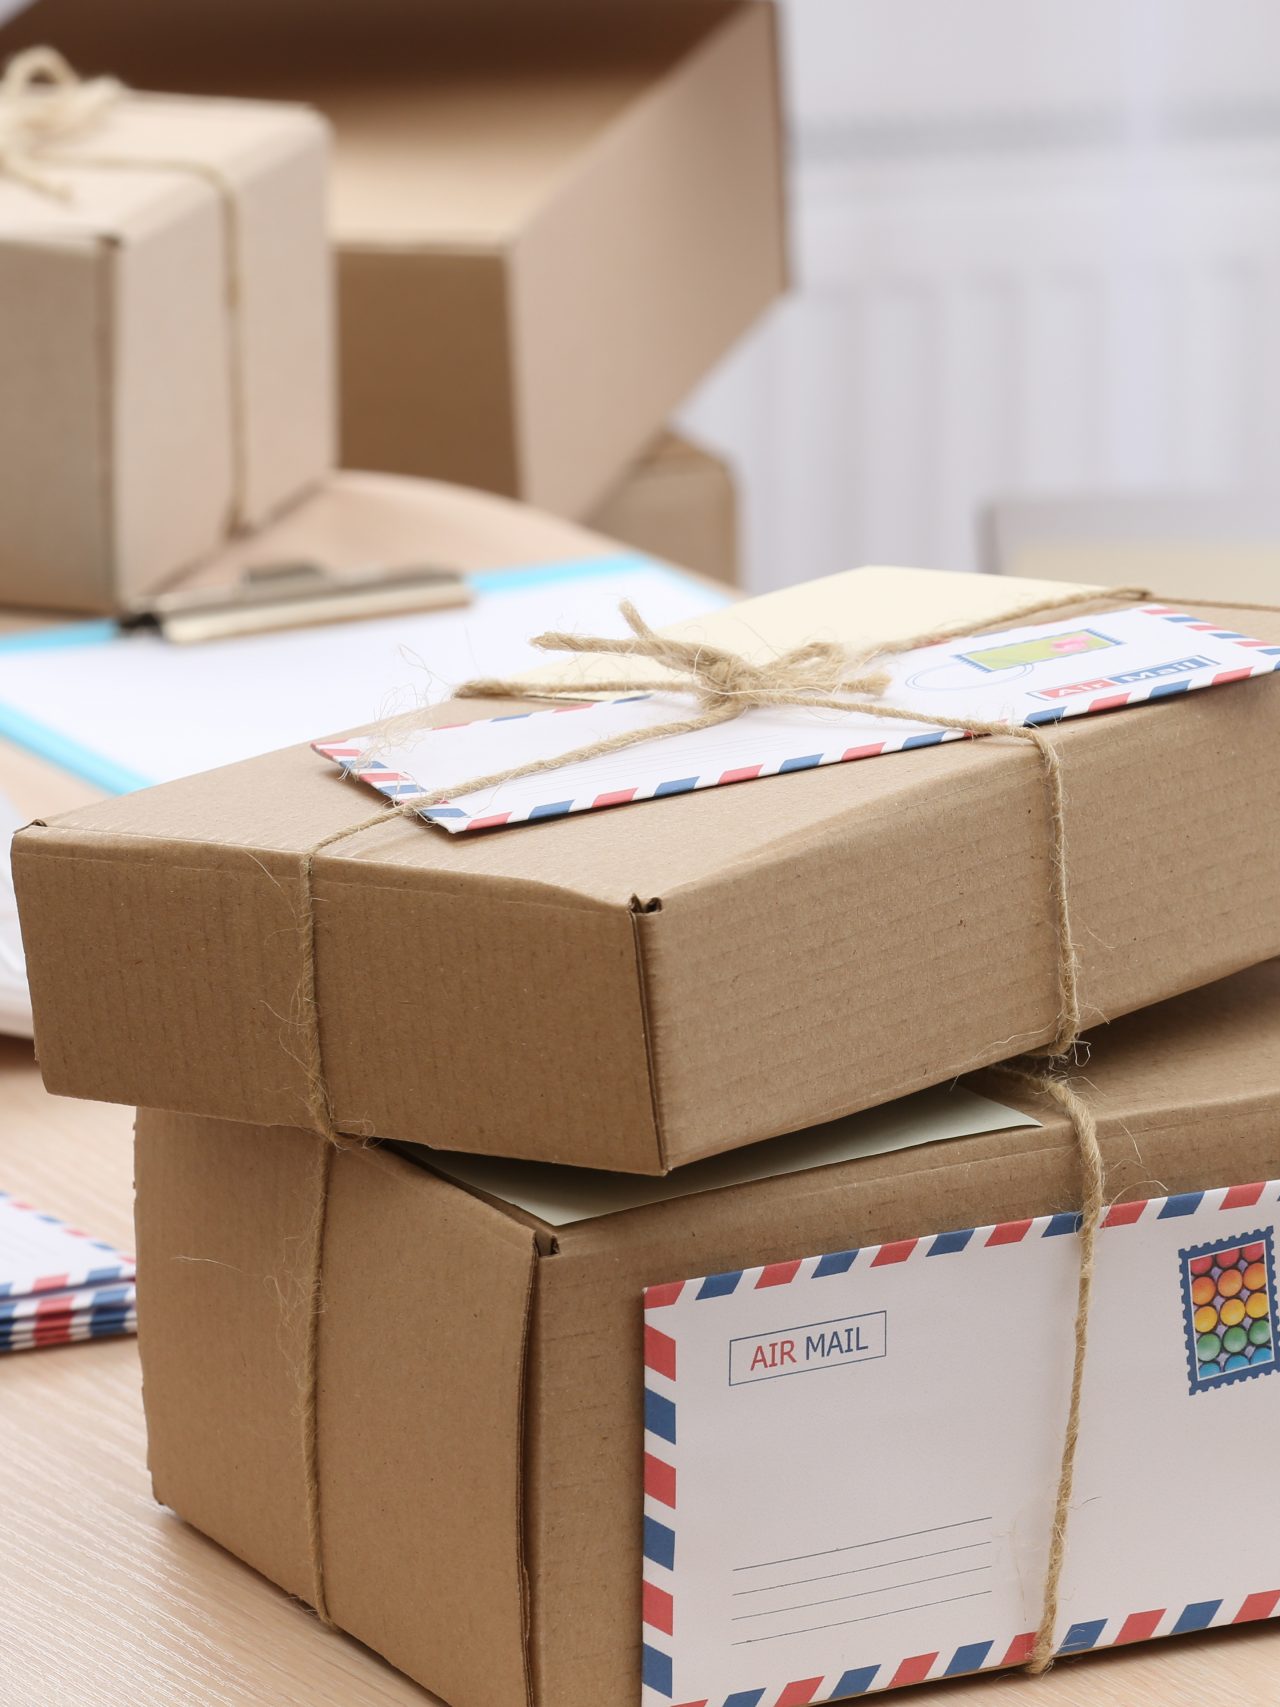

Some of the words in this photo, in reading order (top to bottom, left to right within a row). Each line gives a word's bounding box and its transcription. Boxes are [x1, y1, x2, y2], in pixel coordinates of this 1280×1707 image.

[1057, 680, 1105, 697] Air
[1120, 661, 1199, 683] Mail
[749, 1339, 797, 1371] AIR
[805, 1326, 869, 1360] MAIL
